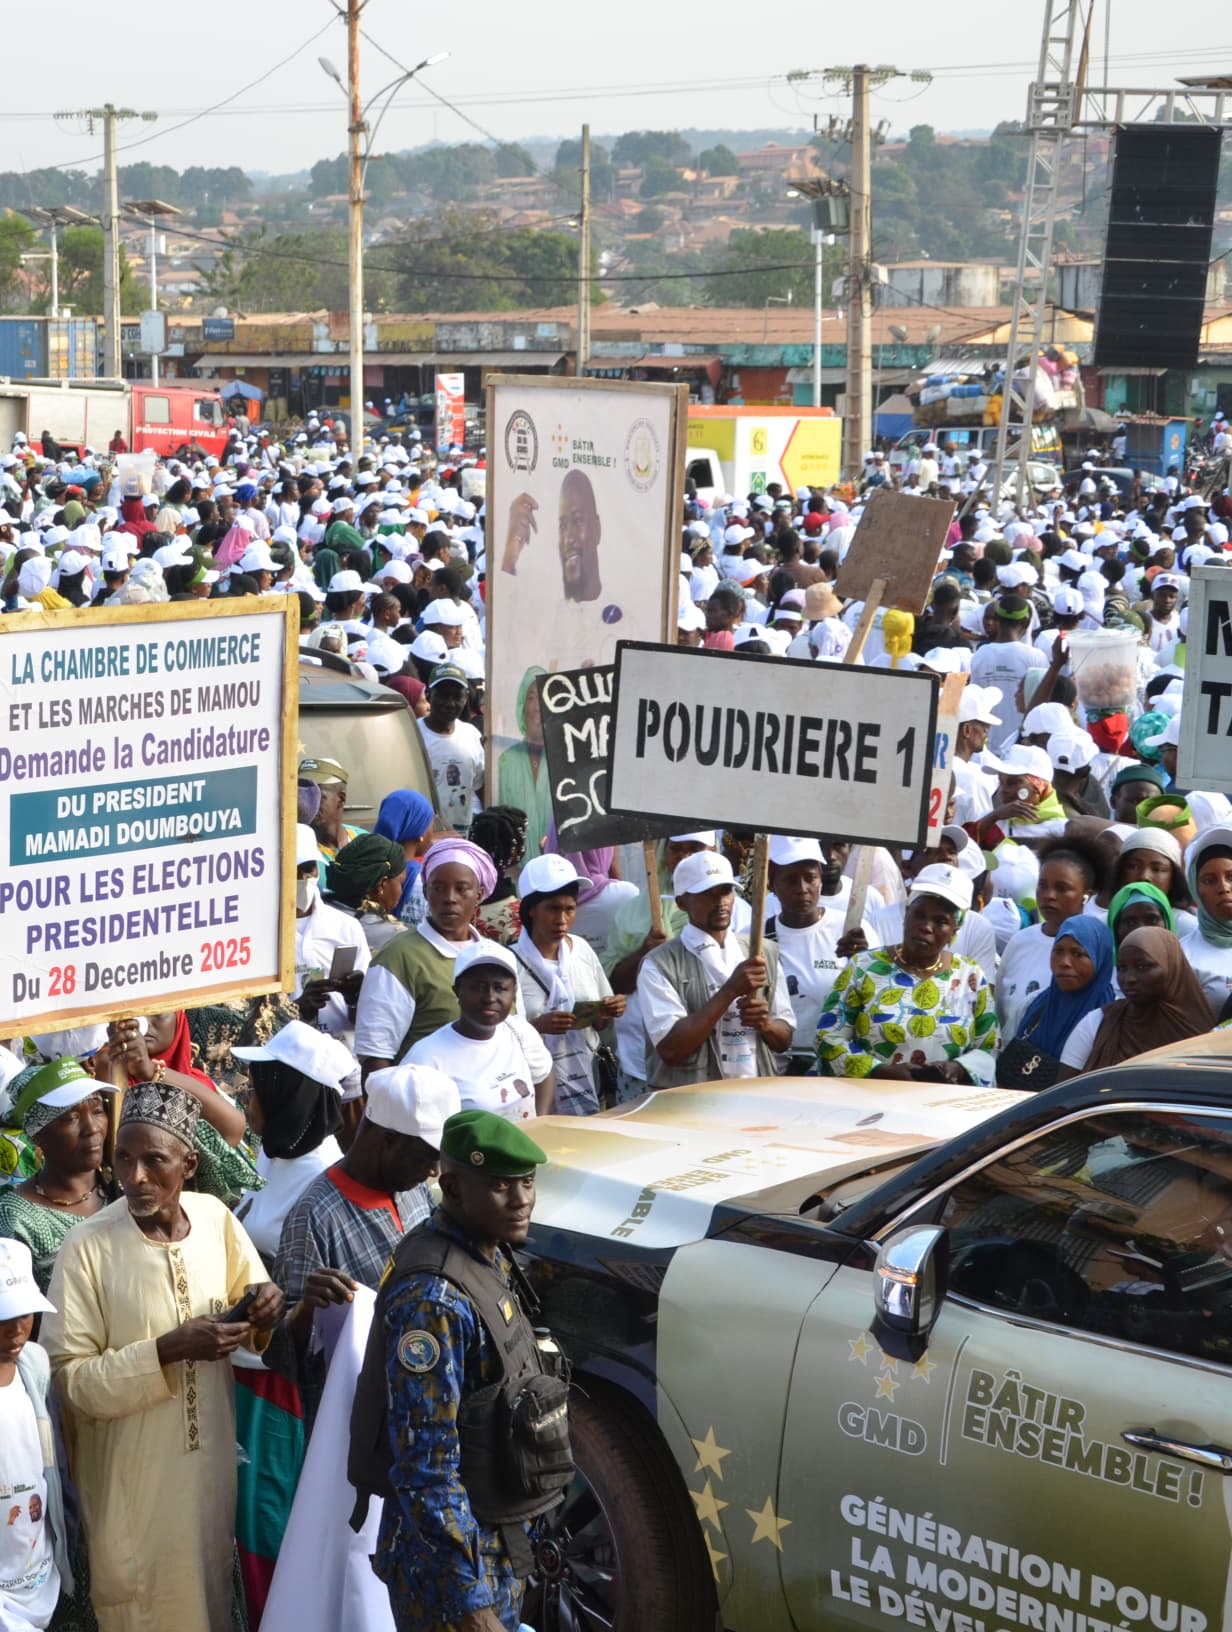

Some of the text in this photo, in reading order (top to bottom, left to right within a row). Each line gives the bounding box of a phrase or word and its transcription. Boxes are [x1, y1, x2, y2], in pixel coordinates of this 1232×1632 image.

[552, 457, 569, 469] GMD
[11, 633, 261, 685] LA CHAMBRE DE COMMERCE
[9, 680, 261, 731] ET LES MARCHES DE MAMOU
[1201, 681, 1232, 737] T
[114, 736, 133, 769] la
[141, 725, 270, 767] Candidature
[635, 698, 916, 788] POUDRIERE 1
[57, 779, 206, 818] DU PRESIDENT
[25, 808, 242, 856] MAMADI DOUMBOUYA
[0, 847, 265, 914] POUR LES ELECTIONS
[26, 894, 239, 955] PRESIDENTELLE
[12, 936, 251, 1003] Du 28 Decembre 2025
[838, 1402, 927, 1456] GMD
[967, 1369, 1086, 1436] BÂTIR
[962, 1402, 1184, 1503] ENSEMBLE
[830, 1570, 871, 1608] LE
[840, 1494, 1208, 1632] GÉNÉRATION POUR
[851, 1536, 1132, 1632] LA MODERNIT
